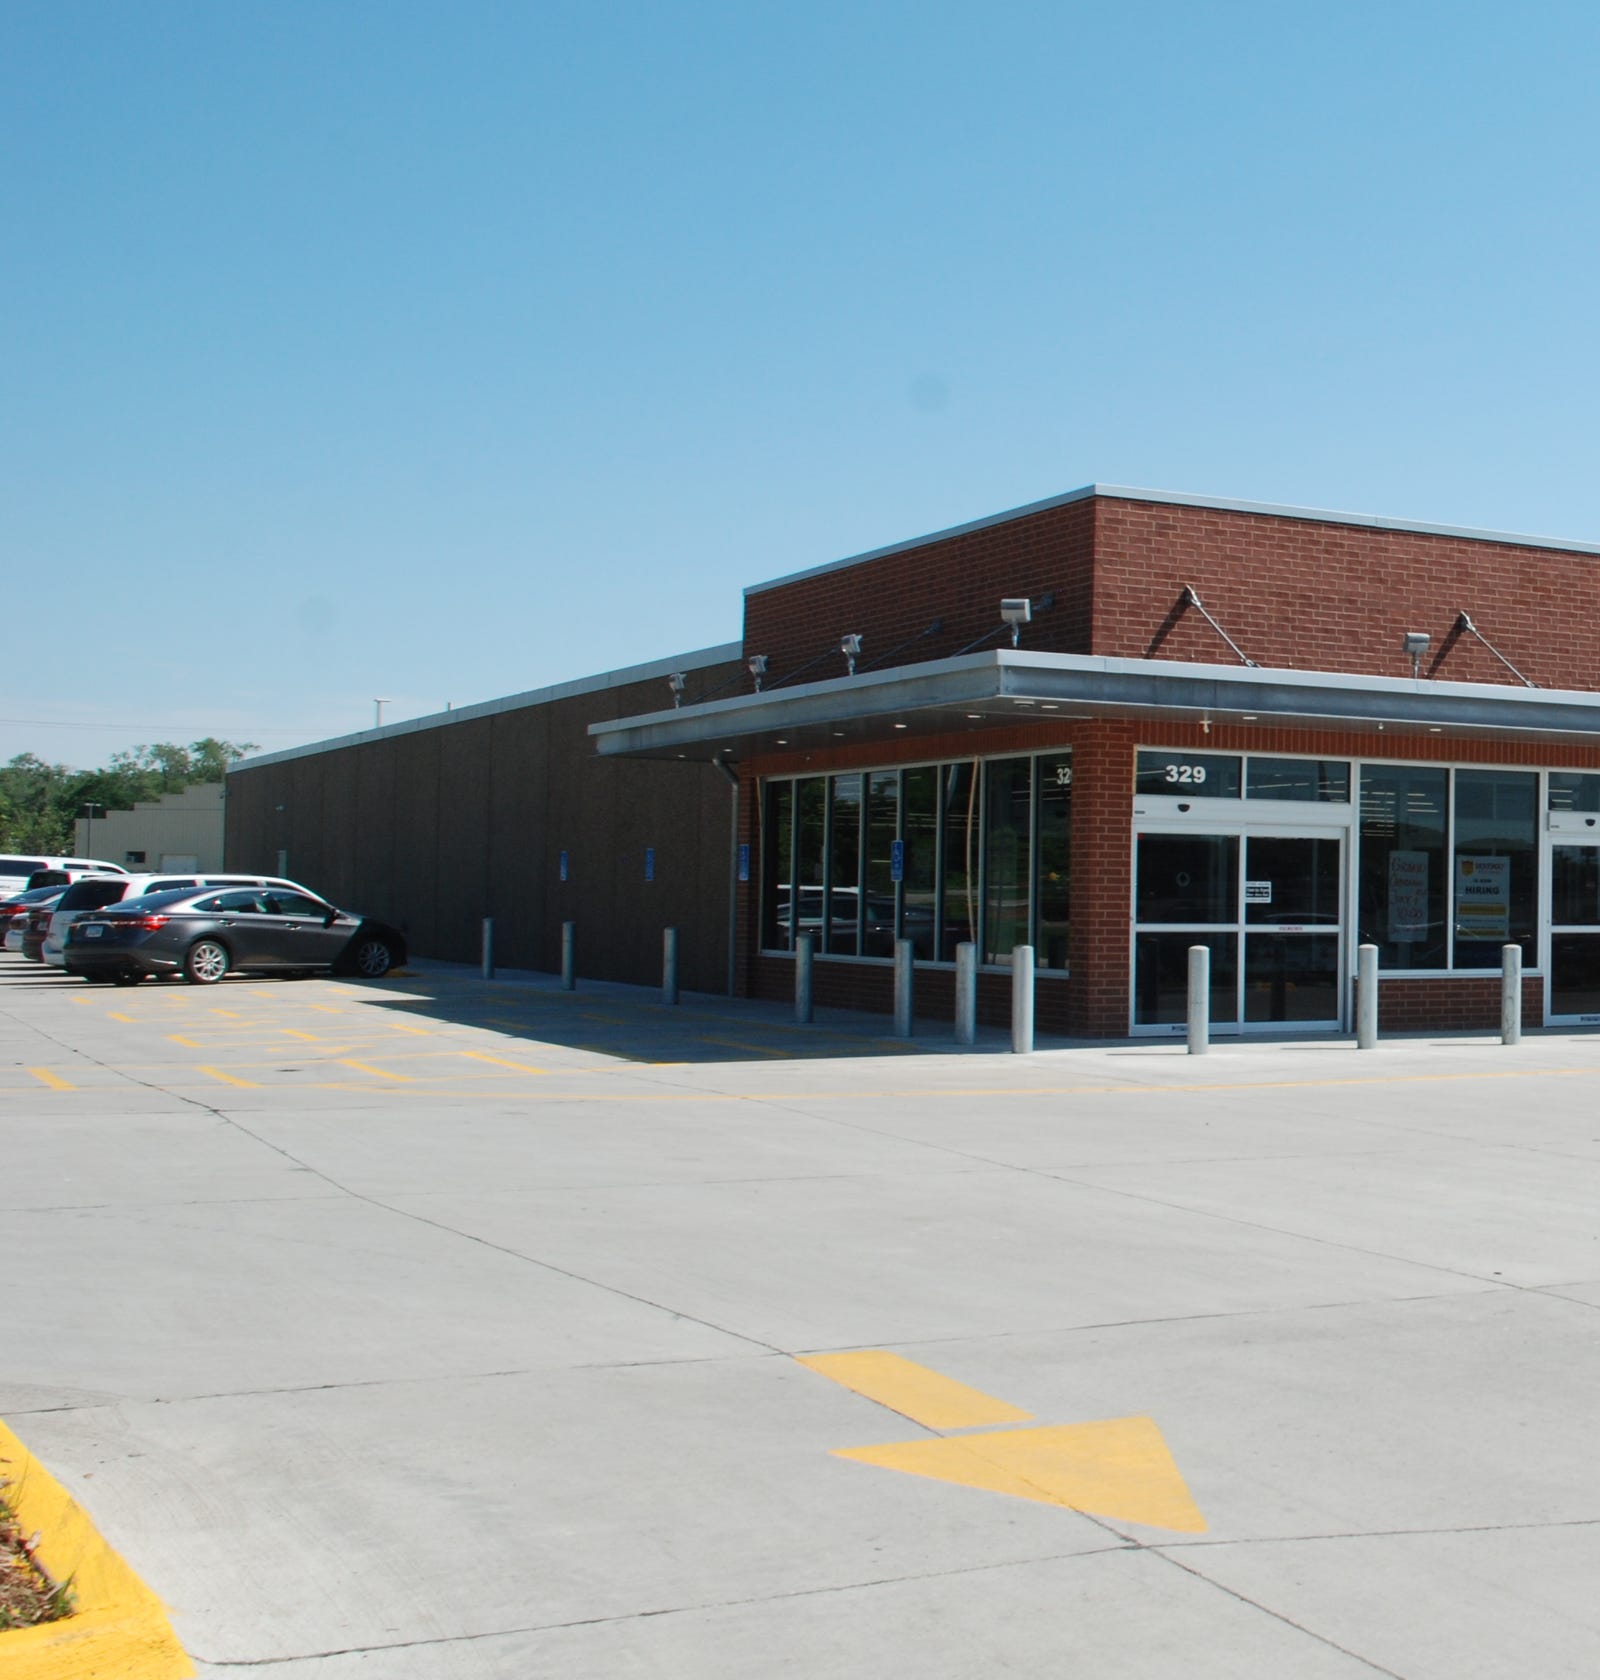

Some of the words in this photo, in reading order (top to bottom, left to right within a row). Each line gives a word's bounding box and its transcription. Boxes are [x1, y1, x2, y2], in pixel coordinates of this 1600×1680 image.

[1056, 768, 1072, 785] 32
[1165, 765, 1206, 784] 329
[1465, 886, 1500, 895] HIRING
